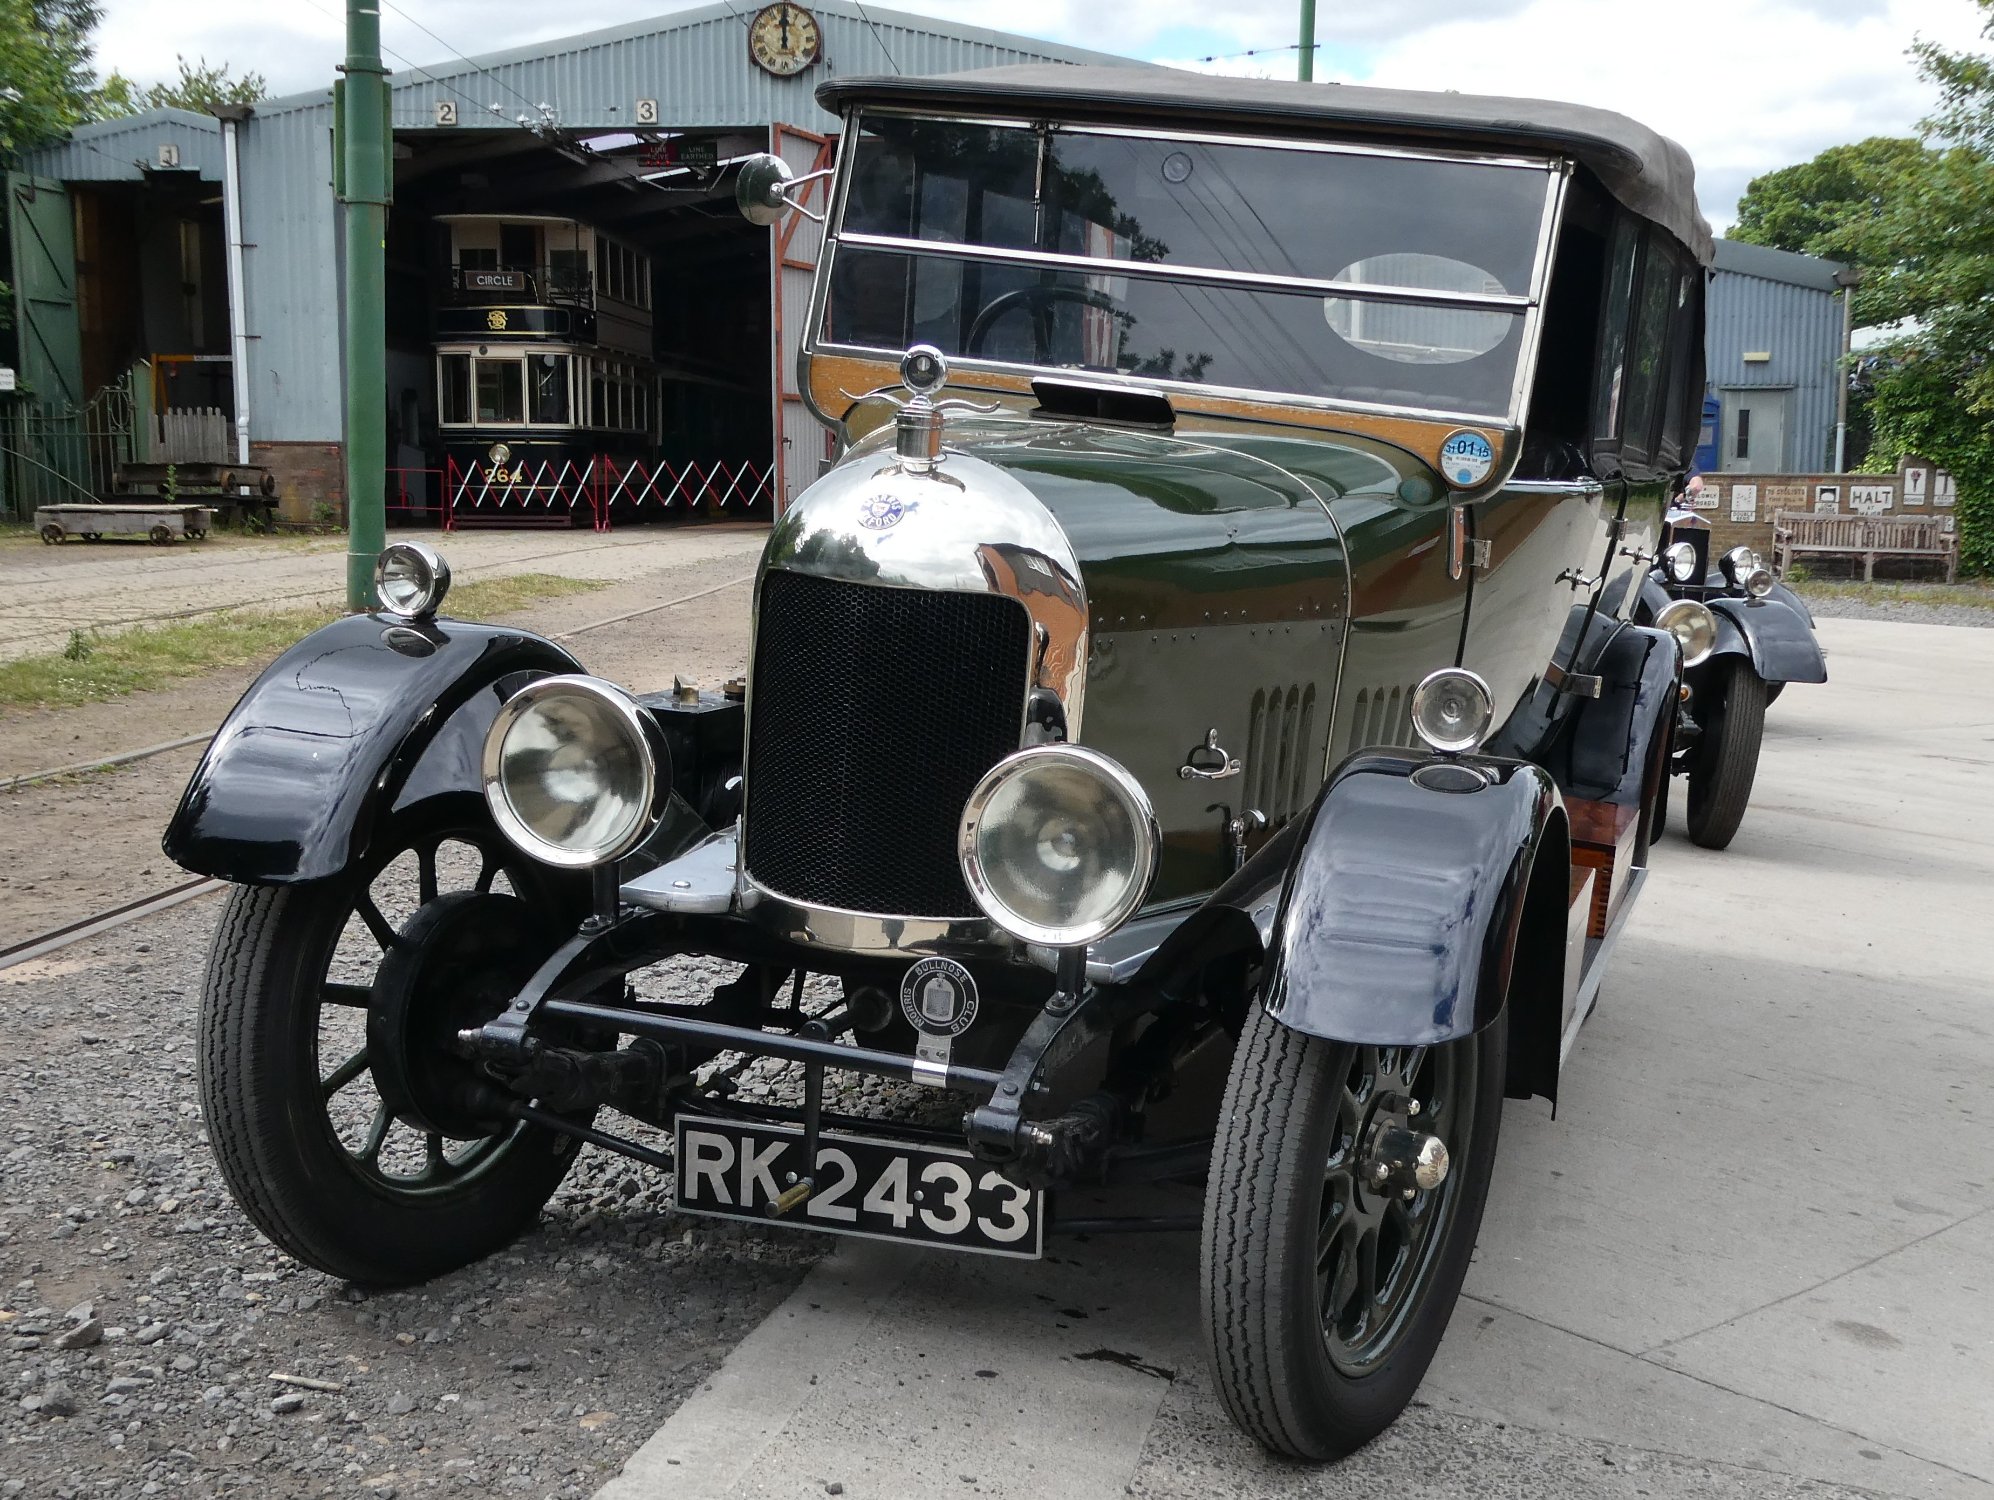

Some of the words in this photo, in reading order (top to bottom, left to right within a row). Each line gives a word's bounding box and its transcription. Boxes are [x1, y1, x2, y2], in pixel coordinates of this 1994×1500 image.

[440, 104, 453, 122] 2
[640, 102, 653, 120] 3
[476, 275, 513, 287] CIRCLE
[1446, 444, 1455, 454] 31
[1457, 440, 1475, 455] 01
[1477, 446, 1490, 457] 15
[484, 468, 523, 483] 264
[1852, 491, 1891, 503] HALT
[914, 960, 968, 983] BULLNOSE
[903, 987, 925, 1027] MORRIS
[950, 1000, 975, 1033] CLUB
[684, 1130, 789, 1208] RK
[807, 1148, 1031, 1242] 2433
